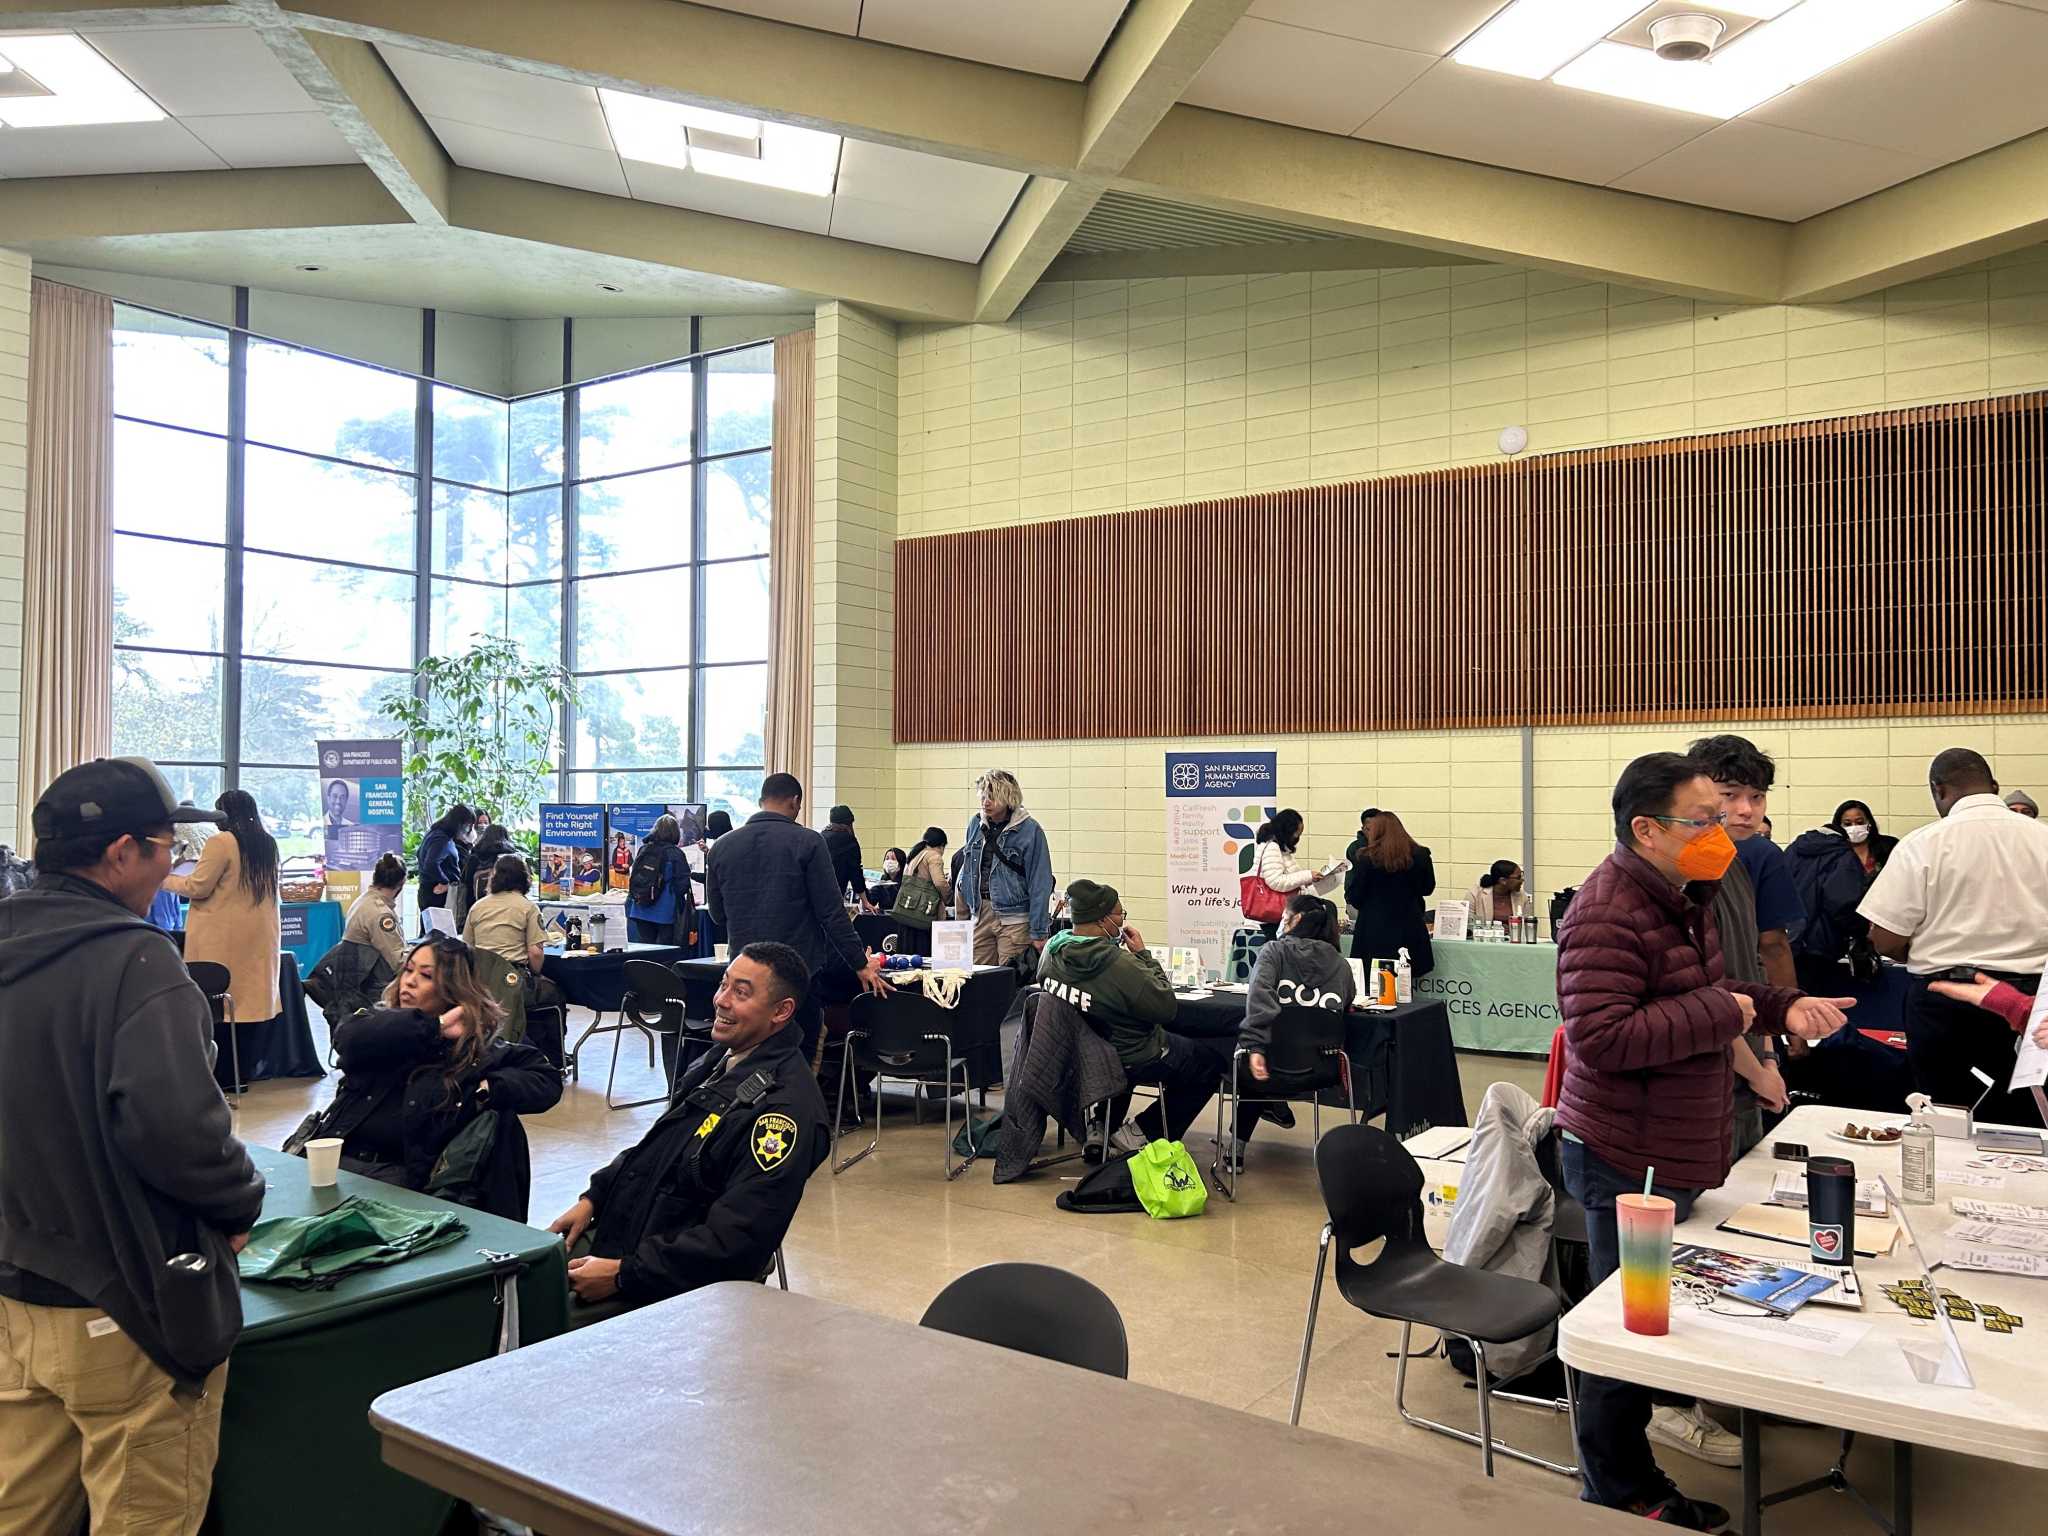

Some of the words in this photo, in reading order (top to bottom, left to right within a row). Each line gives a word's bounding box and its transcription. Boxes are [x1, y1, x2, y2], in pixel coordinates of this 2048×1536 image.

[1204, 764, 1220, 772] SAN
[1222, 764, 1266, 772] FRANCISCO
[1234, 772, 1270, 780] SERVICES
[545, 812, 564, 820] Find
[566, 812, 599, 820] Yourself
[545, 821, 553, 829] in
[555, 821, 569, 829] the
[570, 821, 593, 830] Right
[1183, 828, 1220, 836] support
[1172, 885, 1197, 894] With
[1200, 887, 1220, 896] you
[1204, 897, 1230, 906] life's
[1190, 936, 1218, 944] health
[1412, 979, 1472, 995] CISCO
[1043, 977, 1092, 1012] STAFF
[1444, 999, 1481, 1015] CES
[1487, 1002, 1561, 1019] AGENCY
[758, 1118, 769, 1126] SAN
[769, 1117, 795, 1132] FRANCISCO
